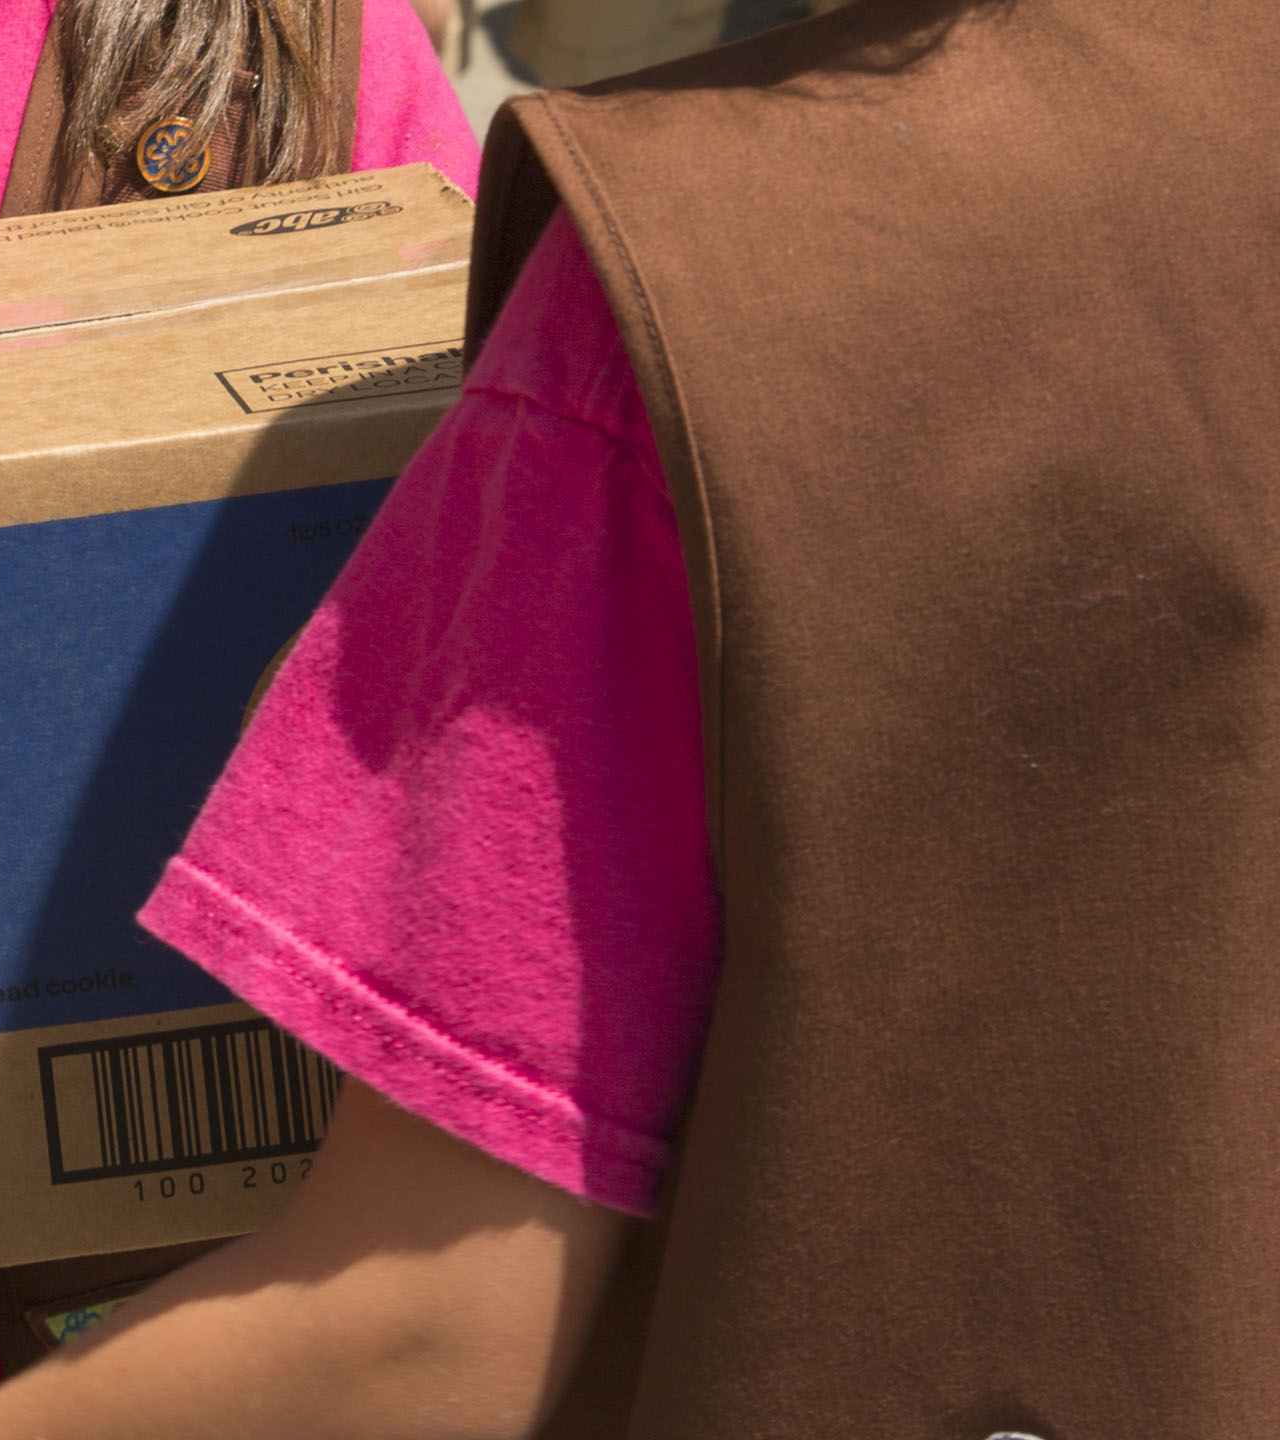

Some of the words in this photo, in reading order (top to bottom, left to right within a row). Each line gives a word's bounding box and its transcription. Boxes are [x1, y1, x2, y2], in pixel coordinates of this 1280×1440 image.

[335, 184, 383, 194] Girl
[164, 203, 212, 214] Girl
[253, 194, 331, 209] Scout
[31, 219, 58, 229] of
[63, 208, 159, 224] Scouts
[256, 208, 342, 234] abc
[17, 223, 102, 239] baked
[259, 374, 349, 393] KEEP
[357, 369, 394, 381] IN
[403, 363, 426, 374] A
[267, 386, 342, 403] DRY
[350, 372, 458, 393] LOCA
[44, 966, 135, 997] cookie
[134, 1173, 205, 1203] 100
